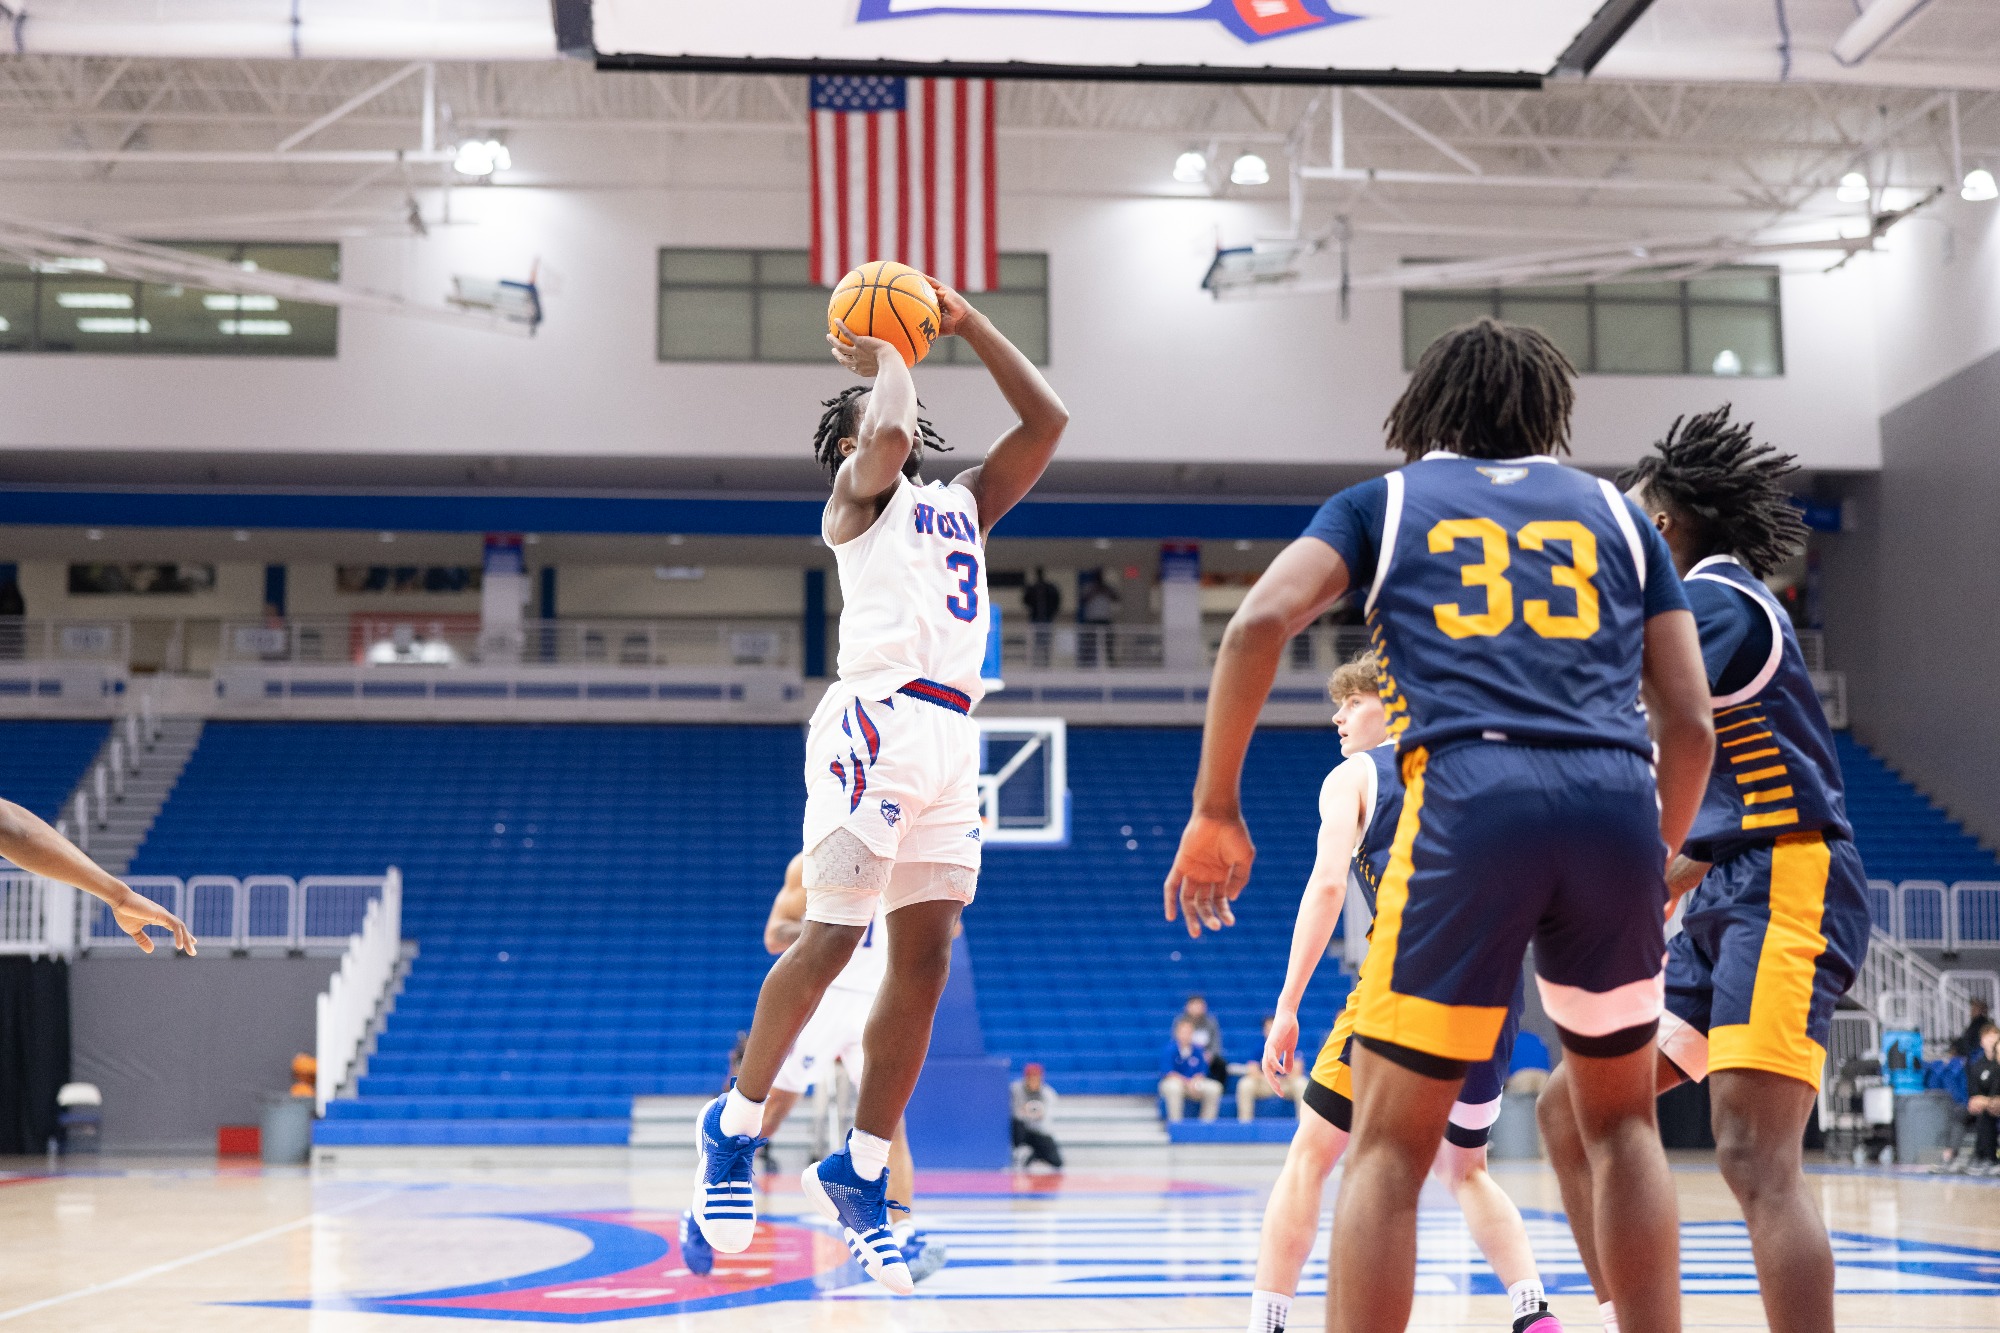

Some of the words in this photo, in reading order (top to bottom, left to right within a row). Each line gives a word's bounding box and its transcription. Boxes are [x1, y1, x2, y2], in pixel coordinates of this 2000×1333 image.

[914, 503, 982, 547] WOLV
[946, 551, 979, 623] 3
[1427, 517, 1600, 640] 33
